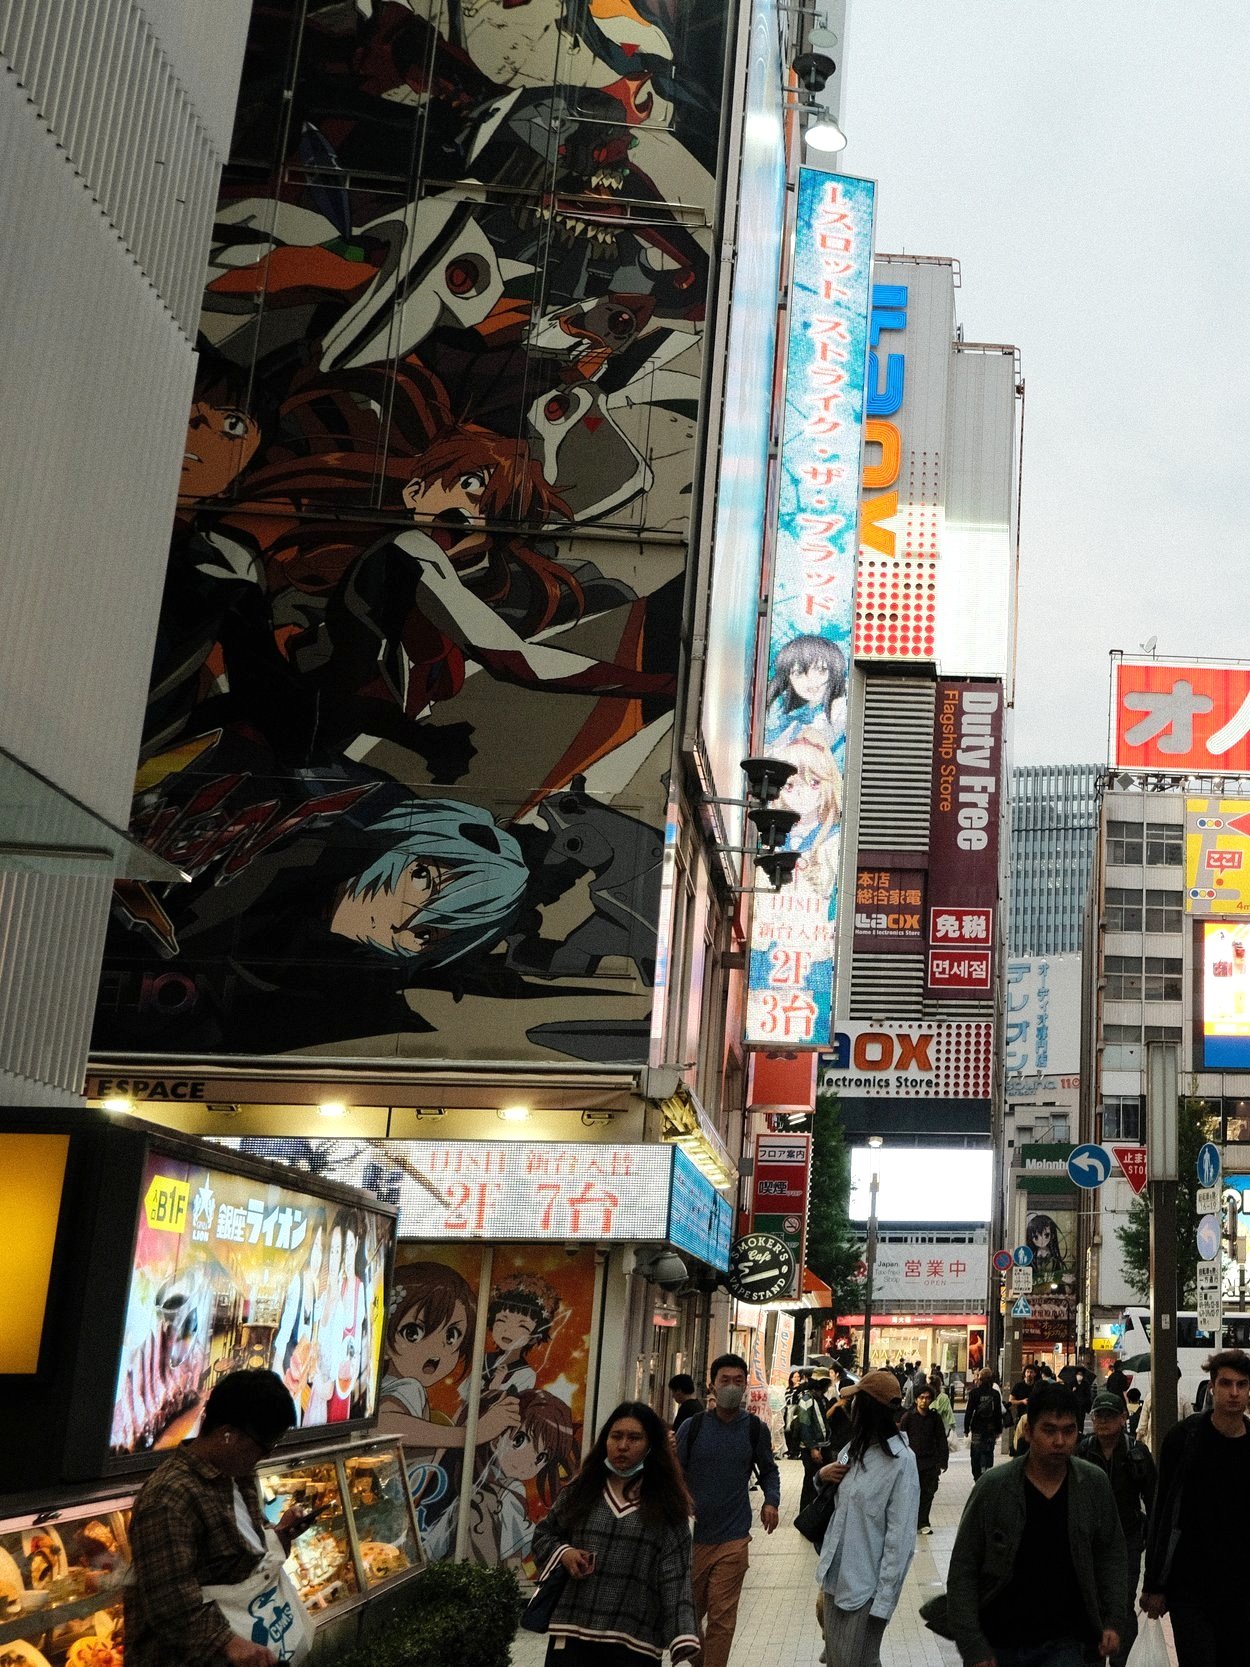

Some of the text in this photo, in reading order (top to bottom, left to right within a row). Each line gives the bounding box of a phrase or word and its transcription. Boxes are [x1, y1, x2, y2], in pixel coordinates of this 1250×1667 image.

[940, 690, 959, 812] Flagship Store
[956, 690, 999, 851] Duty Free
[857, 872, 891, 888] 本店
[856, 889, 922, 906] 総合家電
[935, 914, 987, 939] 免税
[771, 949, 812, 985] 2F
[932, 959, 987, 979] 면세점
[96, 1079, 207, 1099] ESPACE
[816, 1075, 934, 1089] lectronics Store
[758, 1149, 806, 1160] フロア案内
[1025, 1158, 1069, 1170] Melonb
[758, 1180, 788, 1196] 喫煙
[156, 1185, 186, 1225] B1F
[215, 1197, 308, 1250] 銀座ライオン
[731, 1236, 790, 1262] SMOKER'S
[747, 1249, 772, 1261] Cafe
[904, 1259, 966, 1278] 営業中
[730, 1276, 787, 1301] VAPE STAND
